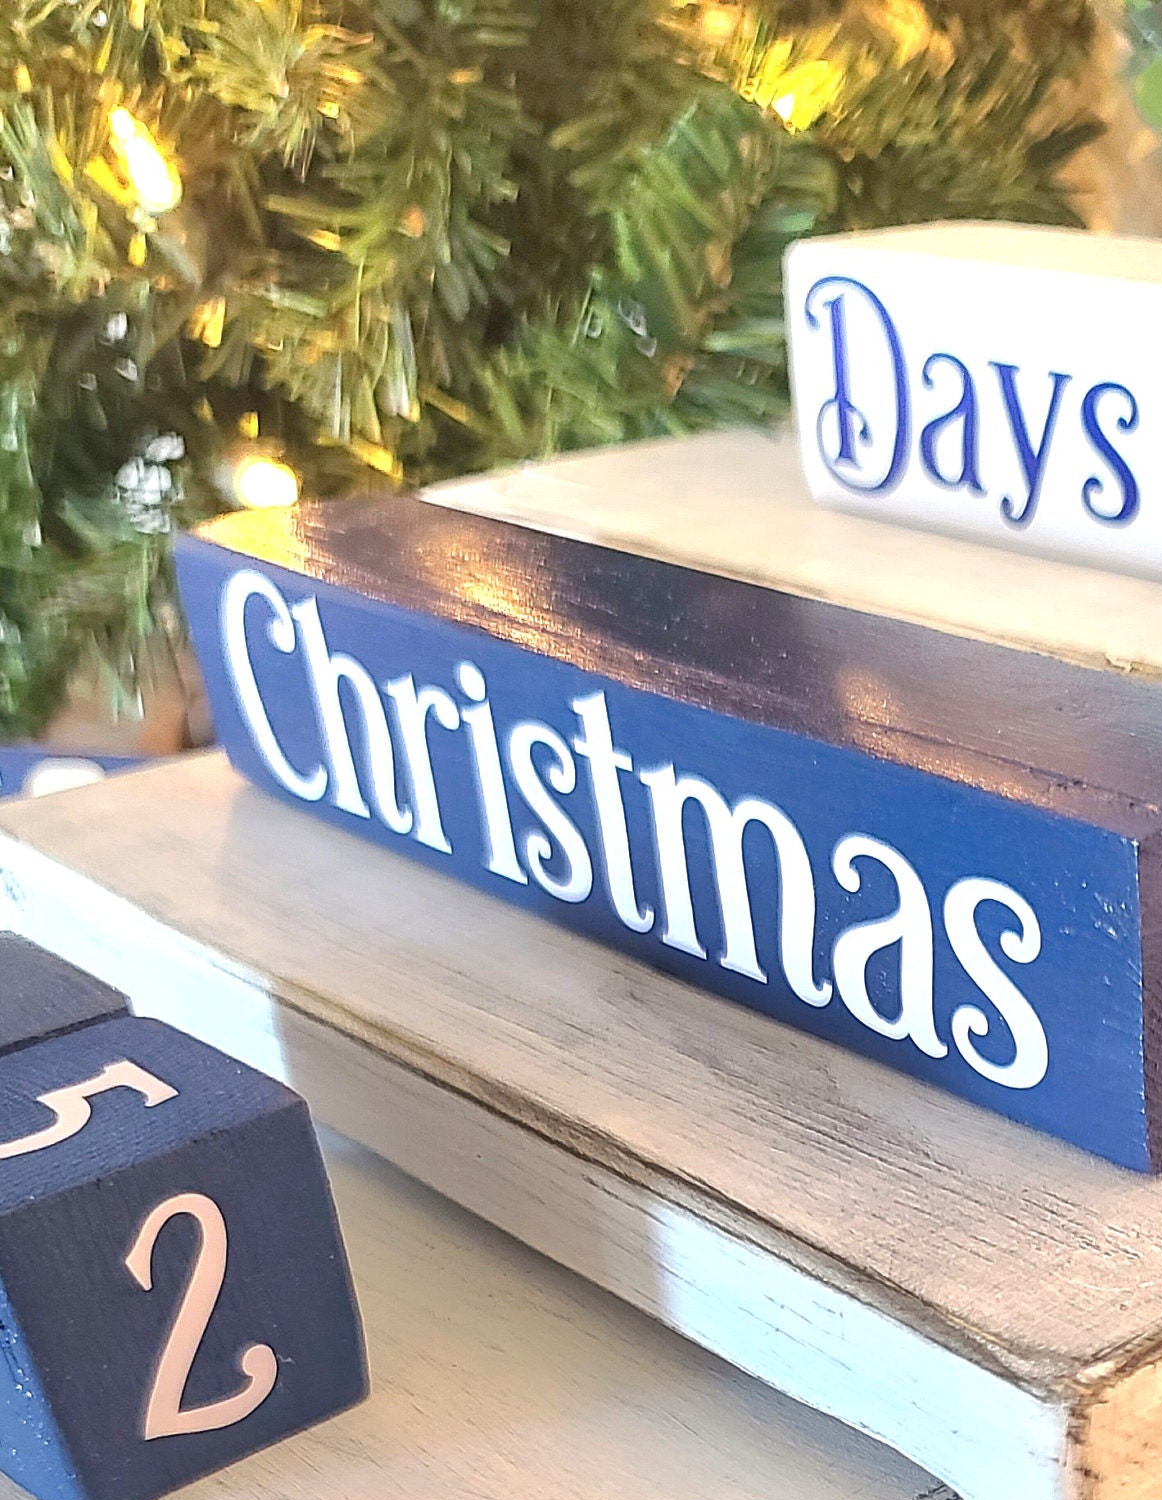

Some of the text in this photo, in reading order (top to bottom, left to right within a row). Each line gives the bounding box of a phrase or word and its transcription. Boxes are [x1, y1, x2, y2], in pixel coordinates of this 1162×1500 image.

[805, 276, 1140, 530] Days
[220, 569, 1049, 1090] Christmas
[125, 1193, 277, 1441] 2
